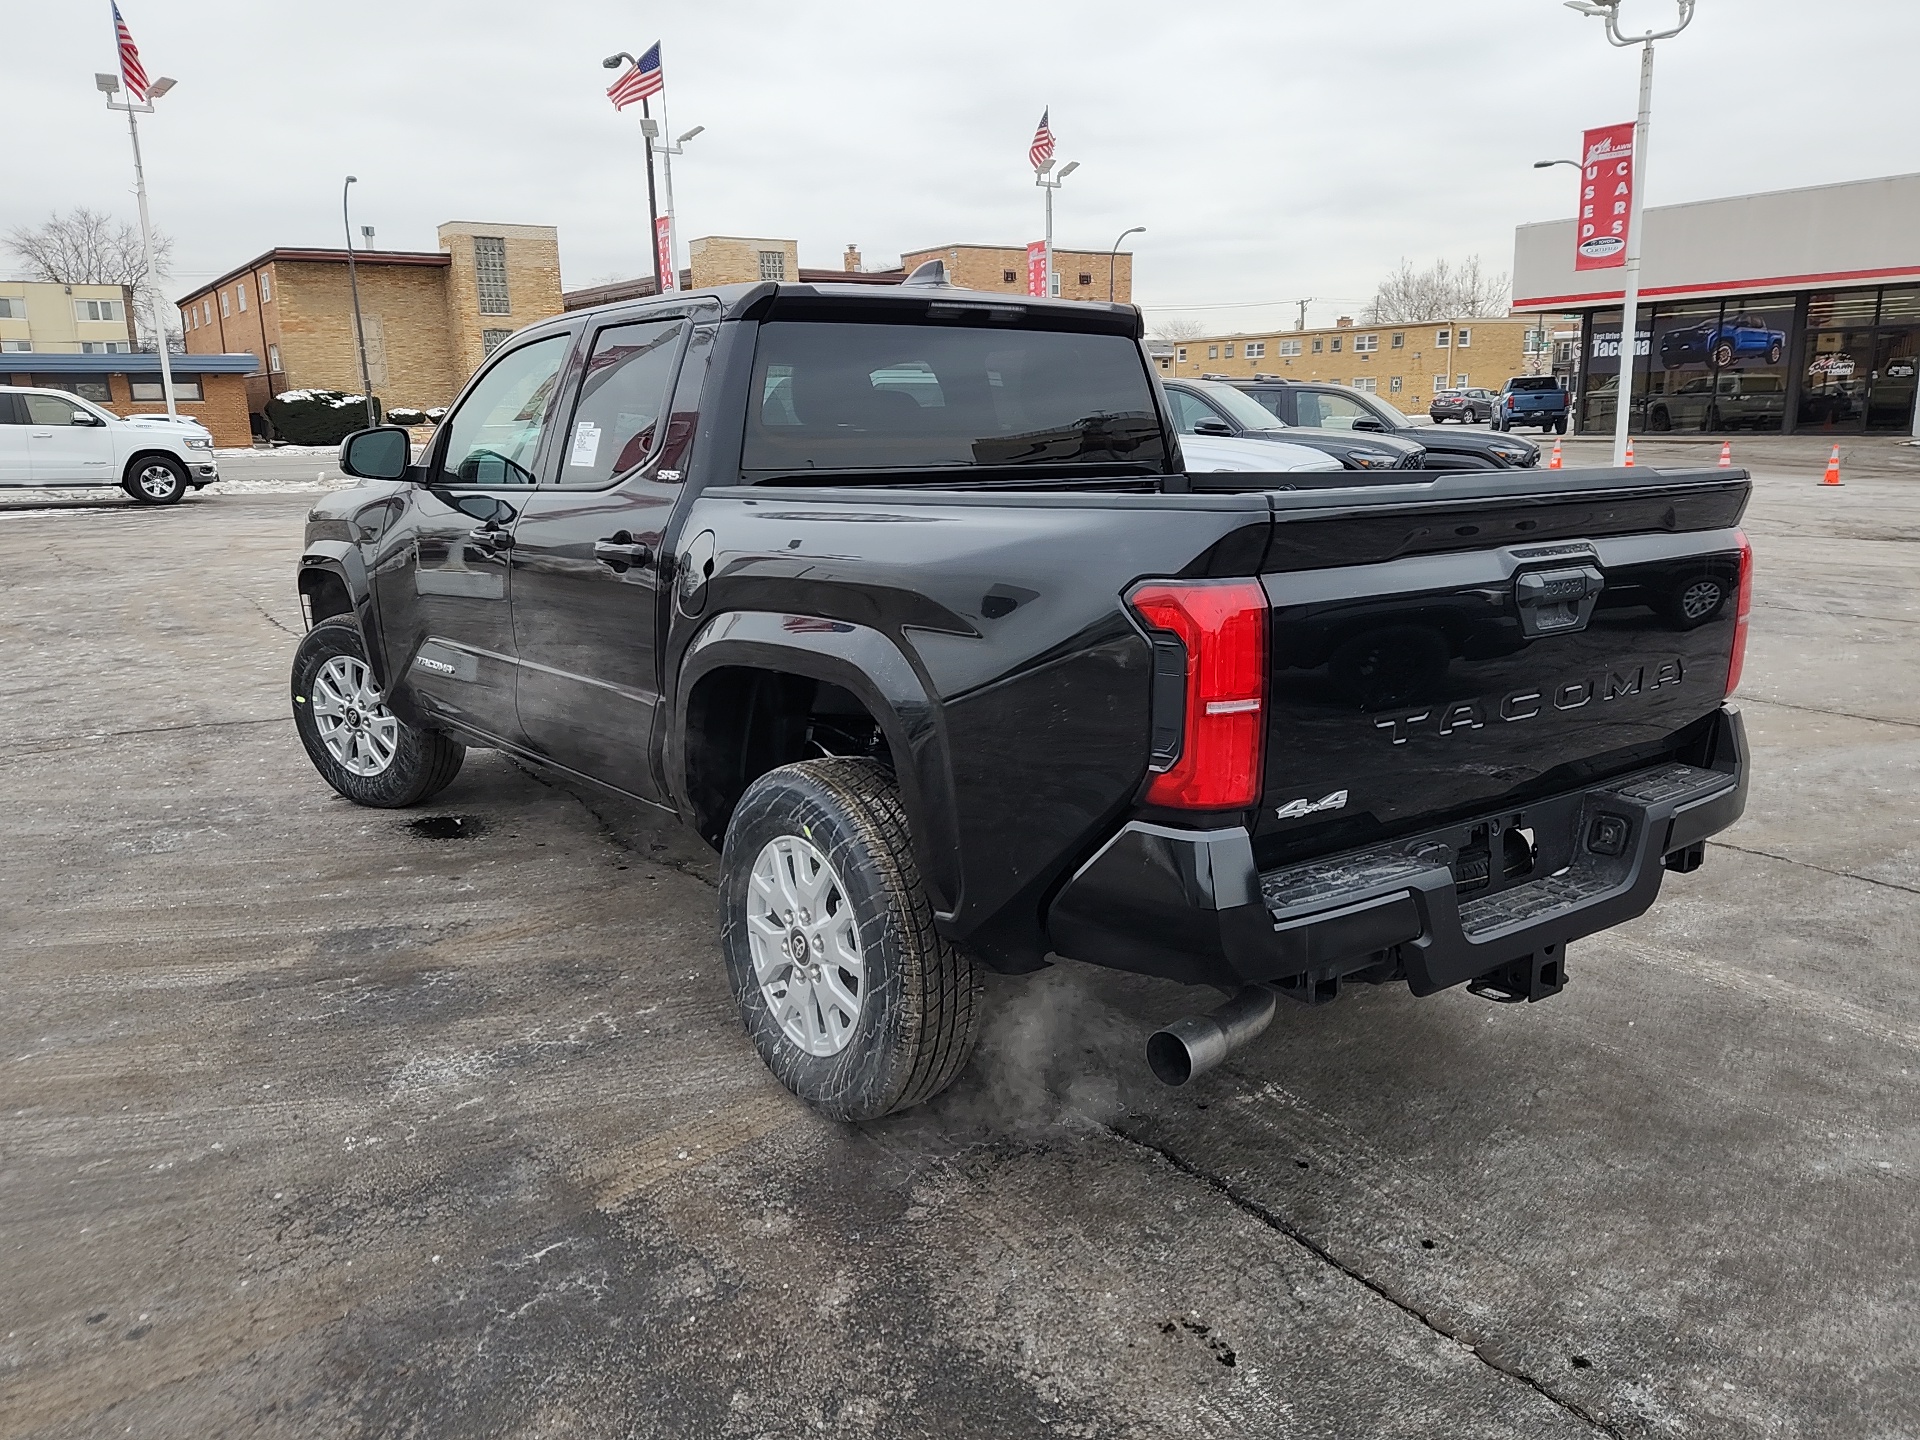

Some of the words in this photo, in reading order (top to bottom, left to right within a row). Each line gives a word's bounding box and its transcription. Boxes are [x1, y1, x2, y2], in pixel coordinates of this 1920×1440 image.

[1612, 143, 1632, 151] LAWN
[1582, 166, 1598, 238] USED
[1611, 161, 1628, 235] CARS
[657, 470, 681, 481] SR5
[1545, 581, 1584, 596] TOYOTA
[416, 656, 456, 674] TACOMA
[1373, 658, 1687, 745] TACOMA
